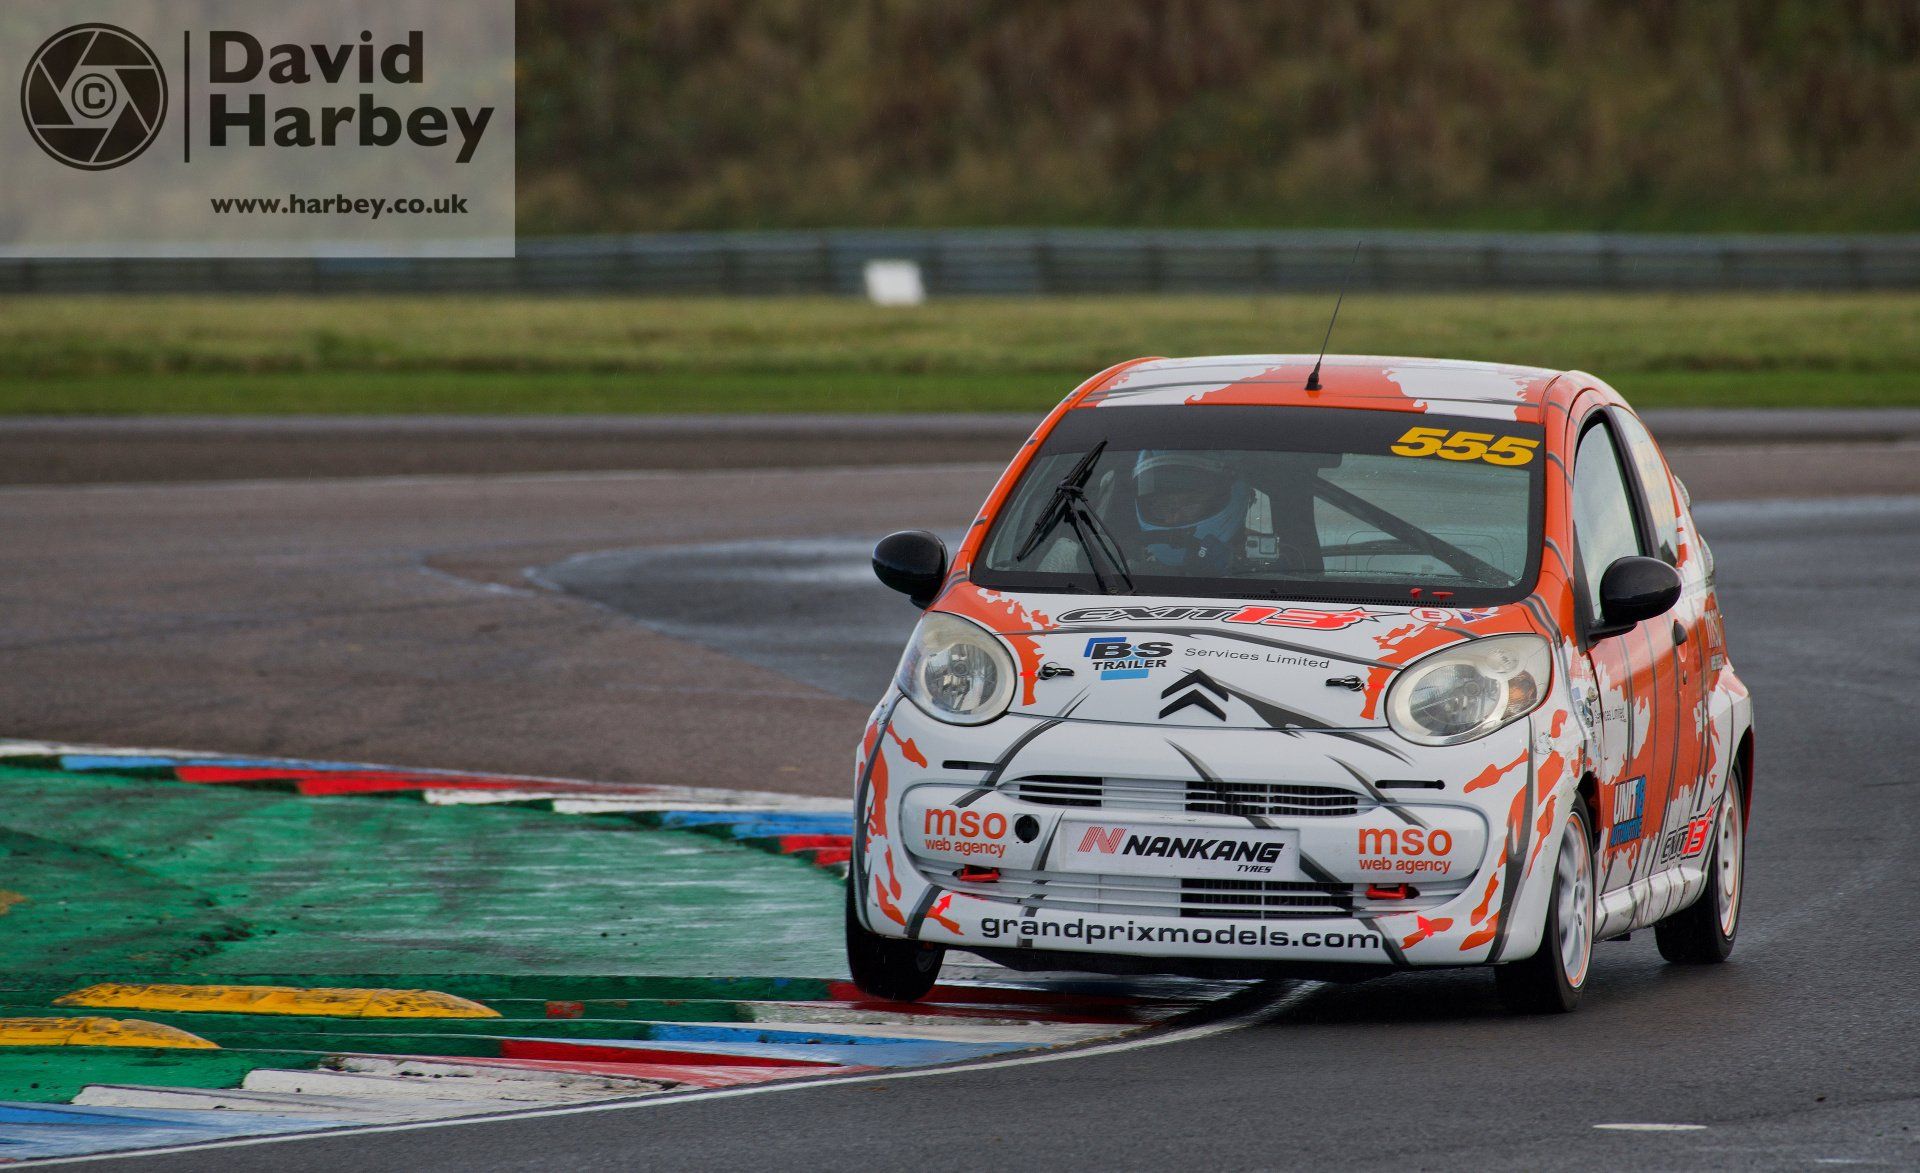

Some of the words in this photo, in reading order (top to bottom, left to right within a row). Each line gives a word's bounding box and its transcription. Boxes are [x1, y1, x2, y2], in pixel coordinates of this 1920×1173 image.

[1390, 426, 1540, 466] 555
[1092, 659, 1167, 671] TRAILER
[1184, 648, 1260, 661] Services
[1266, 653, 1331, 669] Limited
[924, 809, 1007, 839] mso
[925, 837, 951, 851] web
[954, 840, 1006, 858] agency
[1122, 834, 1285, 864] NANKANG
[1358, 828, 1453, 857] mso
[1236, 864, 1273, 874] TYRES
[1359, 857, 1392, 871] web
[1396, 859, 1452, 875] agency
[980, 915, 1380, 949] grandprixmodels.com
